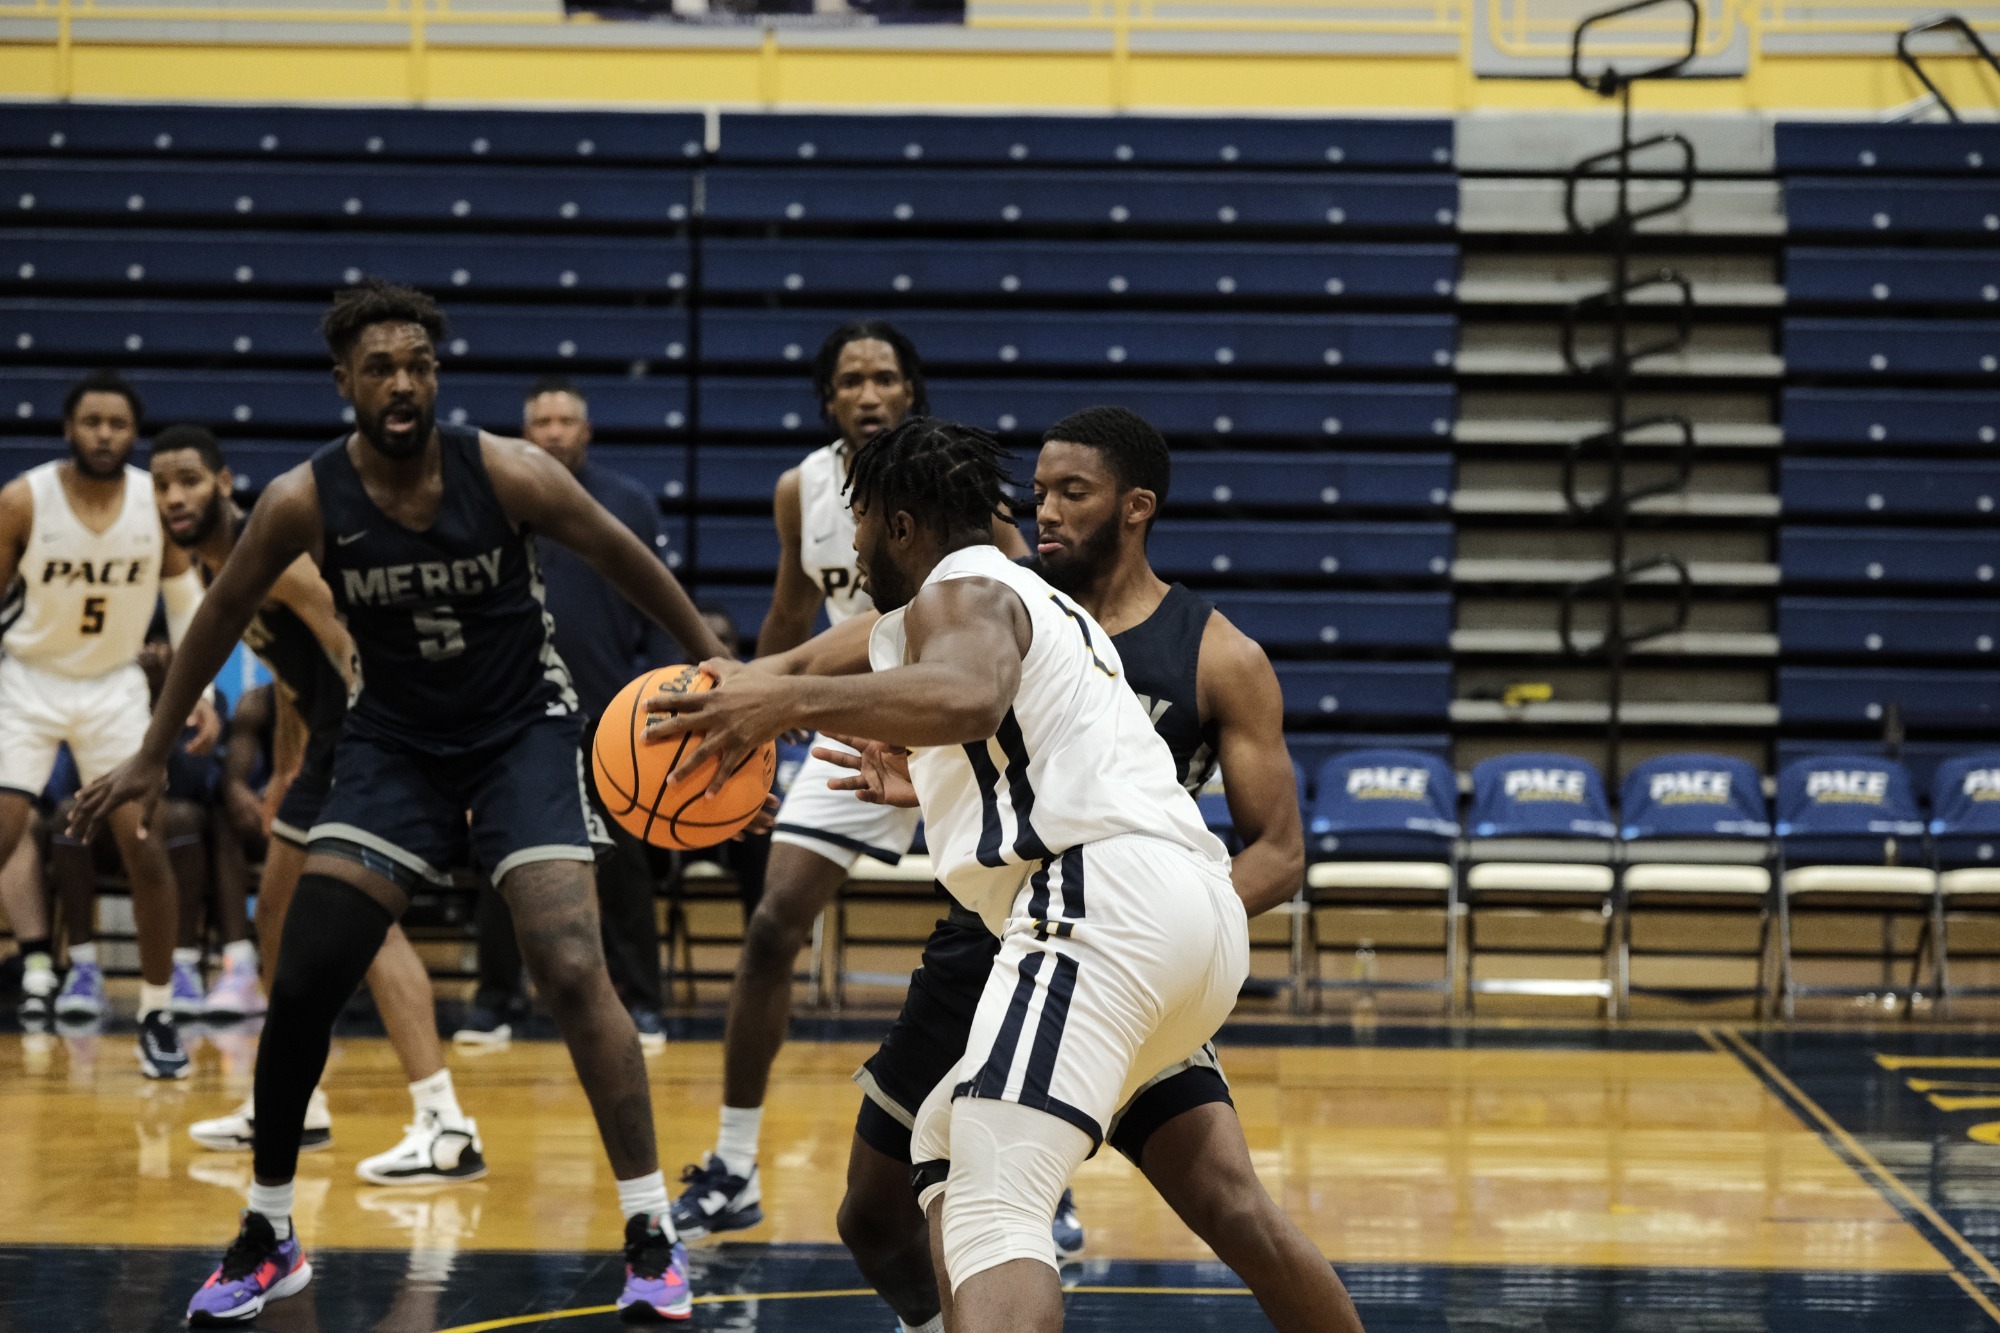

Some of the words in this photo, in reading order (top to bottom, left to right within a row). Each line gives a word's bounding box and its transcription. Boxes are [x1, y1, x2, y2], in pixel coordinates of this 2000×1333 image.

[42, 559, 150, 584] PACE
[341, 547, 502, 606] MERCY
[80, 598, 107, 635] 5
[413, 606, 466, 661] 5
[1346, 767, 1430, 794] PACE
[1504, 769, 1586, 797] PACE
[1649, 771, 1733, 799] PACE
[1806, 771, 1889, 797] PACE
